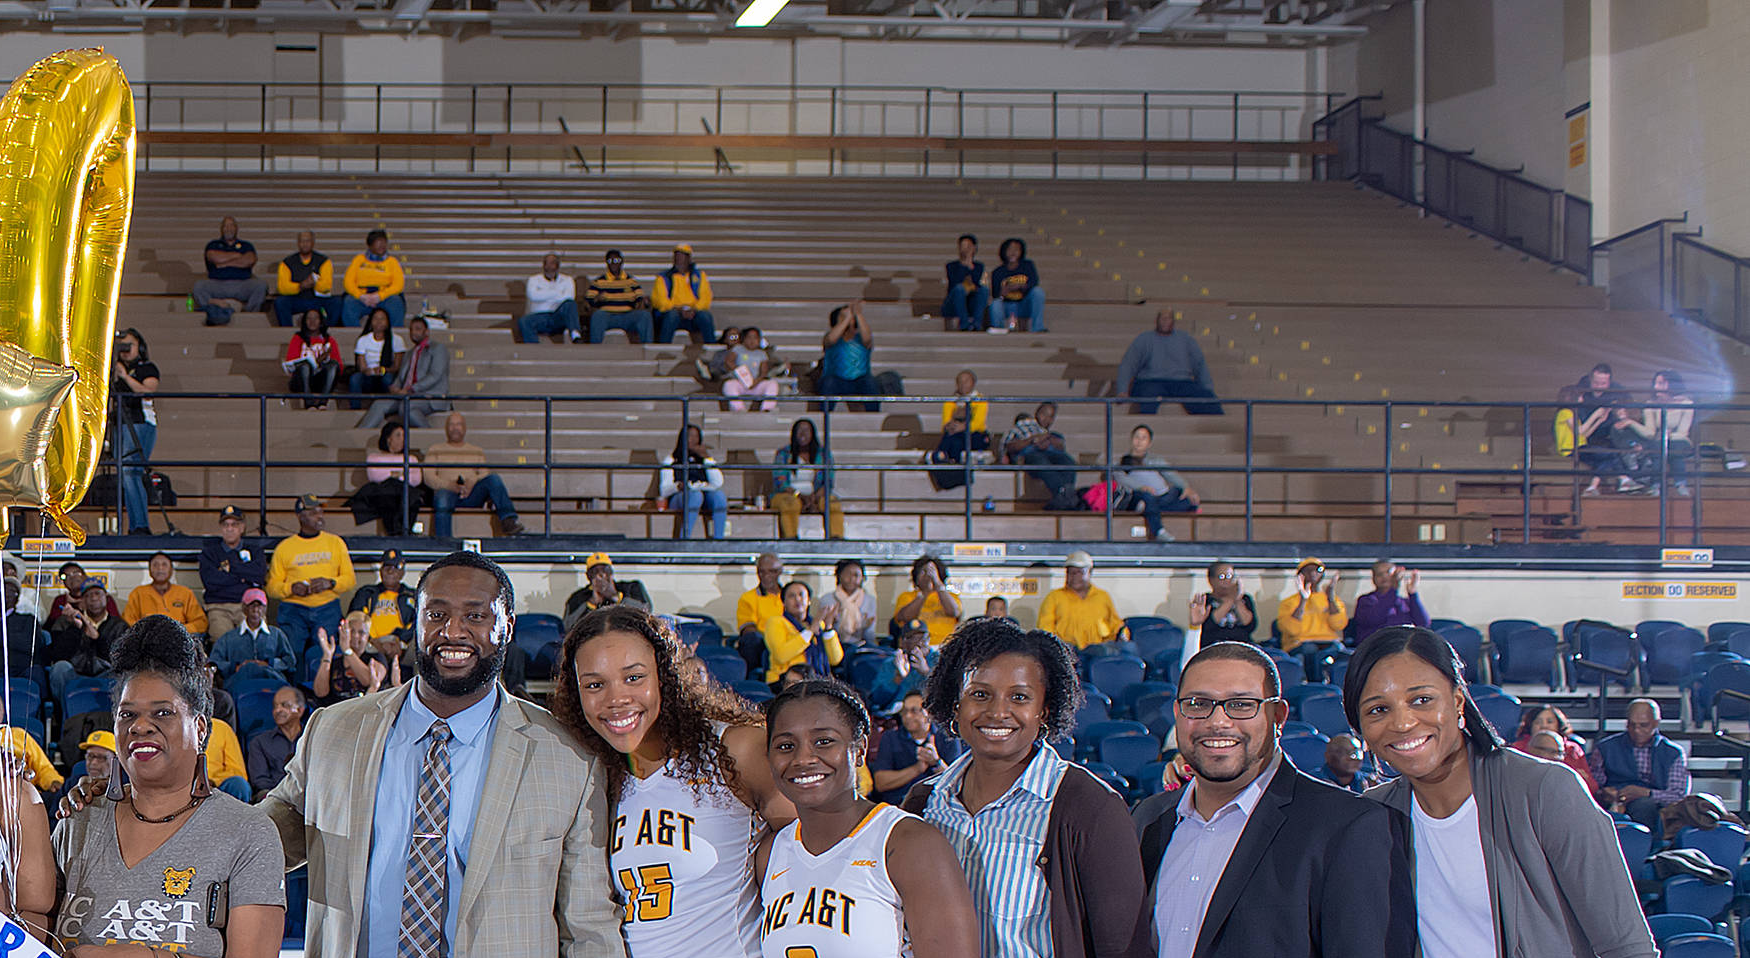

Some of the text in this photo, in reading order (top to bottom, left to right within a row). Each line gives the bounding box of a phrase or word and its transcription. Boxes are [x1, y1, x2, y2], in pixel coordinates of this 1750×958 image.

[1624, 585, 1664, 596] SECTION
[1686, 585, 1736, 596] RESERVED
[611, 808, 696, 855] C A&T
[101, 900, 201, 923] A&T
[761, 886, 856, 942] NC A&T
[96, 919, 197, 943] A&T
